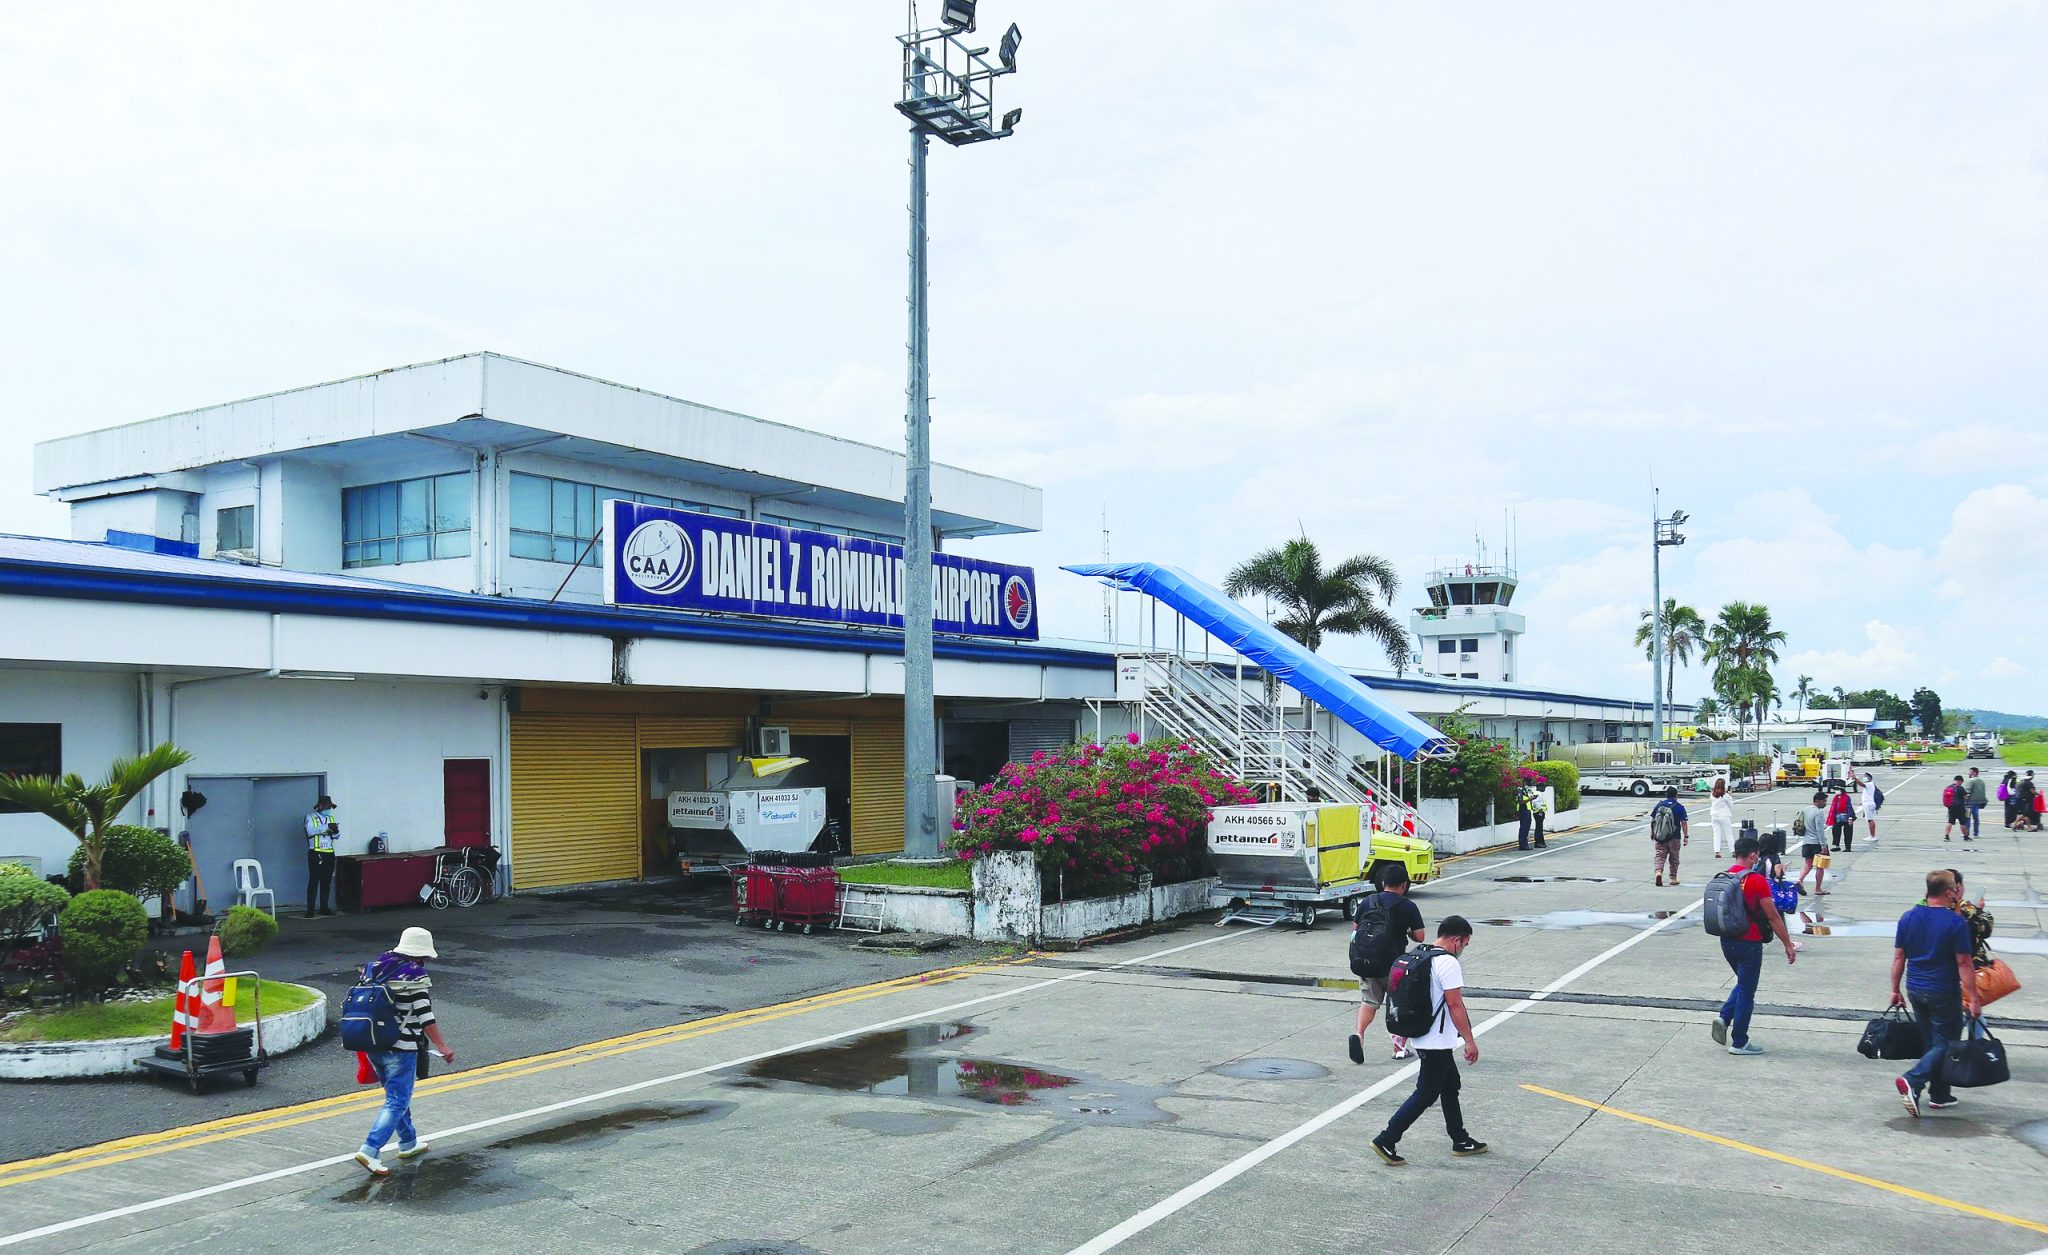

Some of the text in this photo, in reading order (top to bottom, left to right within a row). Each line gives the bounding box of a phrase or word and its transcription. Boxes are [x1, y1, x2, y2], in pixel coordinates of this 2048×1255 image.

[630, 555, 670, 576] CAA
[702, 529, 785, 603] DANIEL
[789, 542, 806, 606] Z.
[811, 545, 906, 616] ROMUALD
[931, 564, 1000, 625] AIRPORT
[678, 796, 719, 805] AKH 41033 5J
[760, 795, 773, 803] AKH
[775, 794, 790, 802] 41033
[1224, 815, 1287, 825] AKH 40566 5J
[1215, 833, 1278, 844] jettainer
